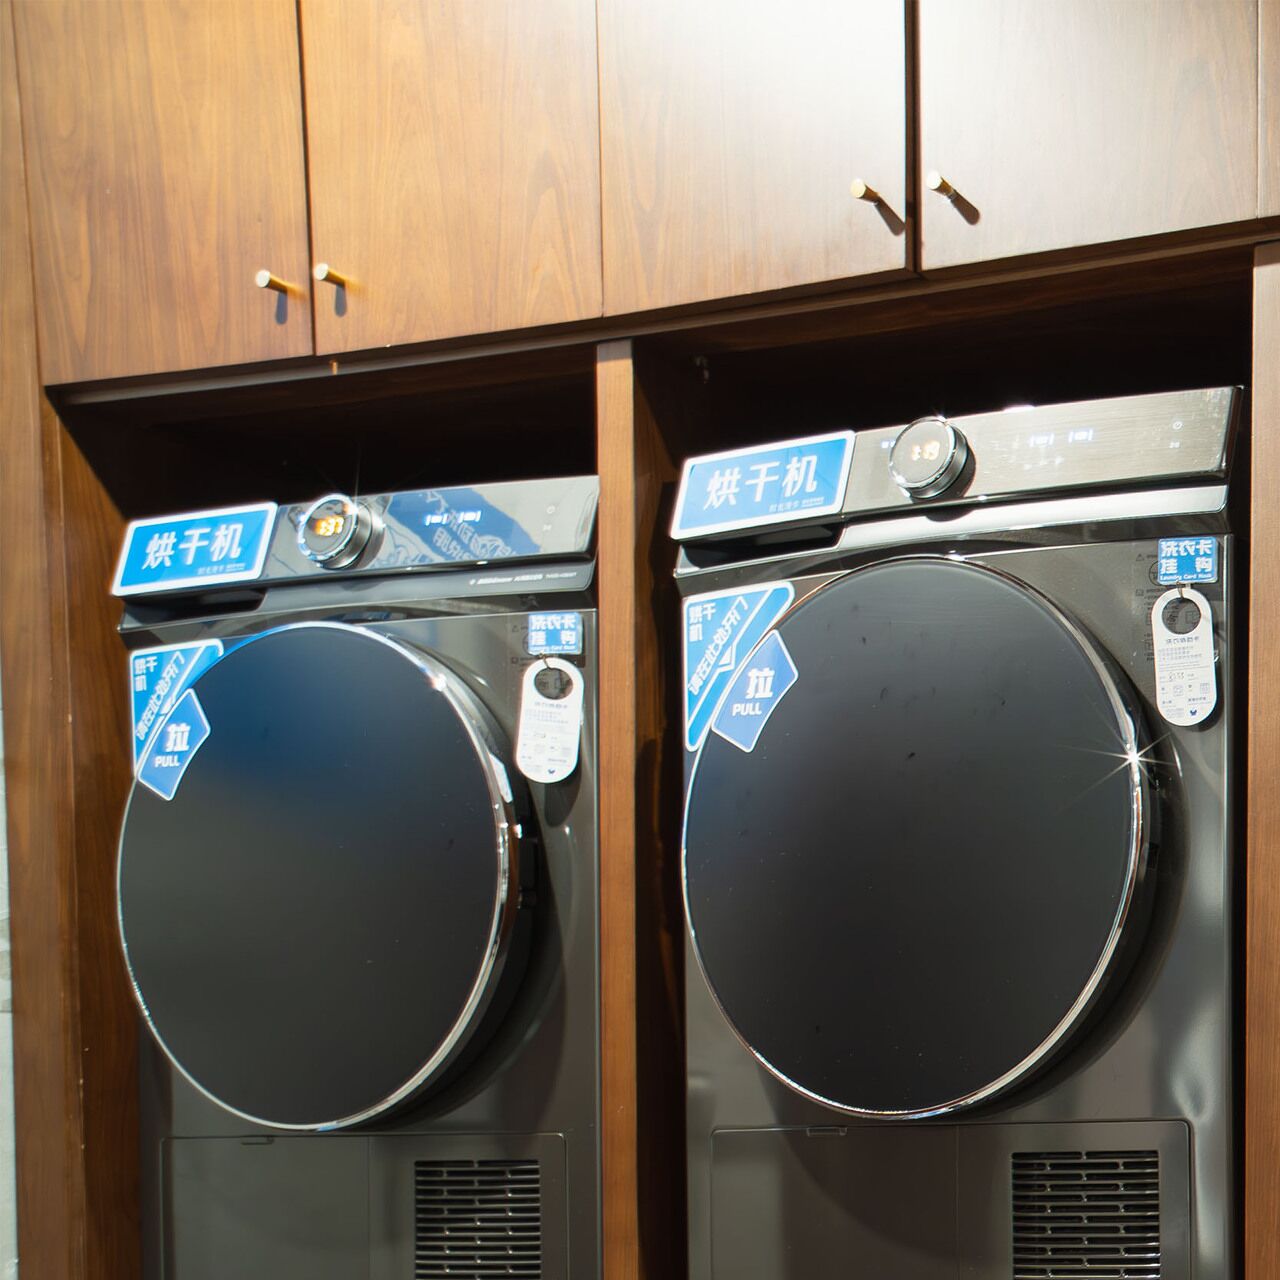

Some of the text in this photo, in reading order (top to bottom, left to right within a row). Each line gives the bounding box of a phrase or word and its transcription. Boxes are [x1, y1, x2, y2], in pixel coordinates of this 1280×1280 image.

[703, 455, 817, 511] 烘干机
[141, 523, 243, 570] 烘干机
[1161, 540, 1212, 557] 洗衣卡
[688, 596, 749, 695] 请在此处开门
[746, 667, 775, 699] 拉
[732, 702, 762, 716] PULL
[165, 723, 191, 752] 拉
[155, 755, 180, 768] PULL
